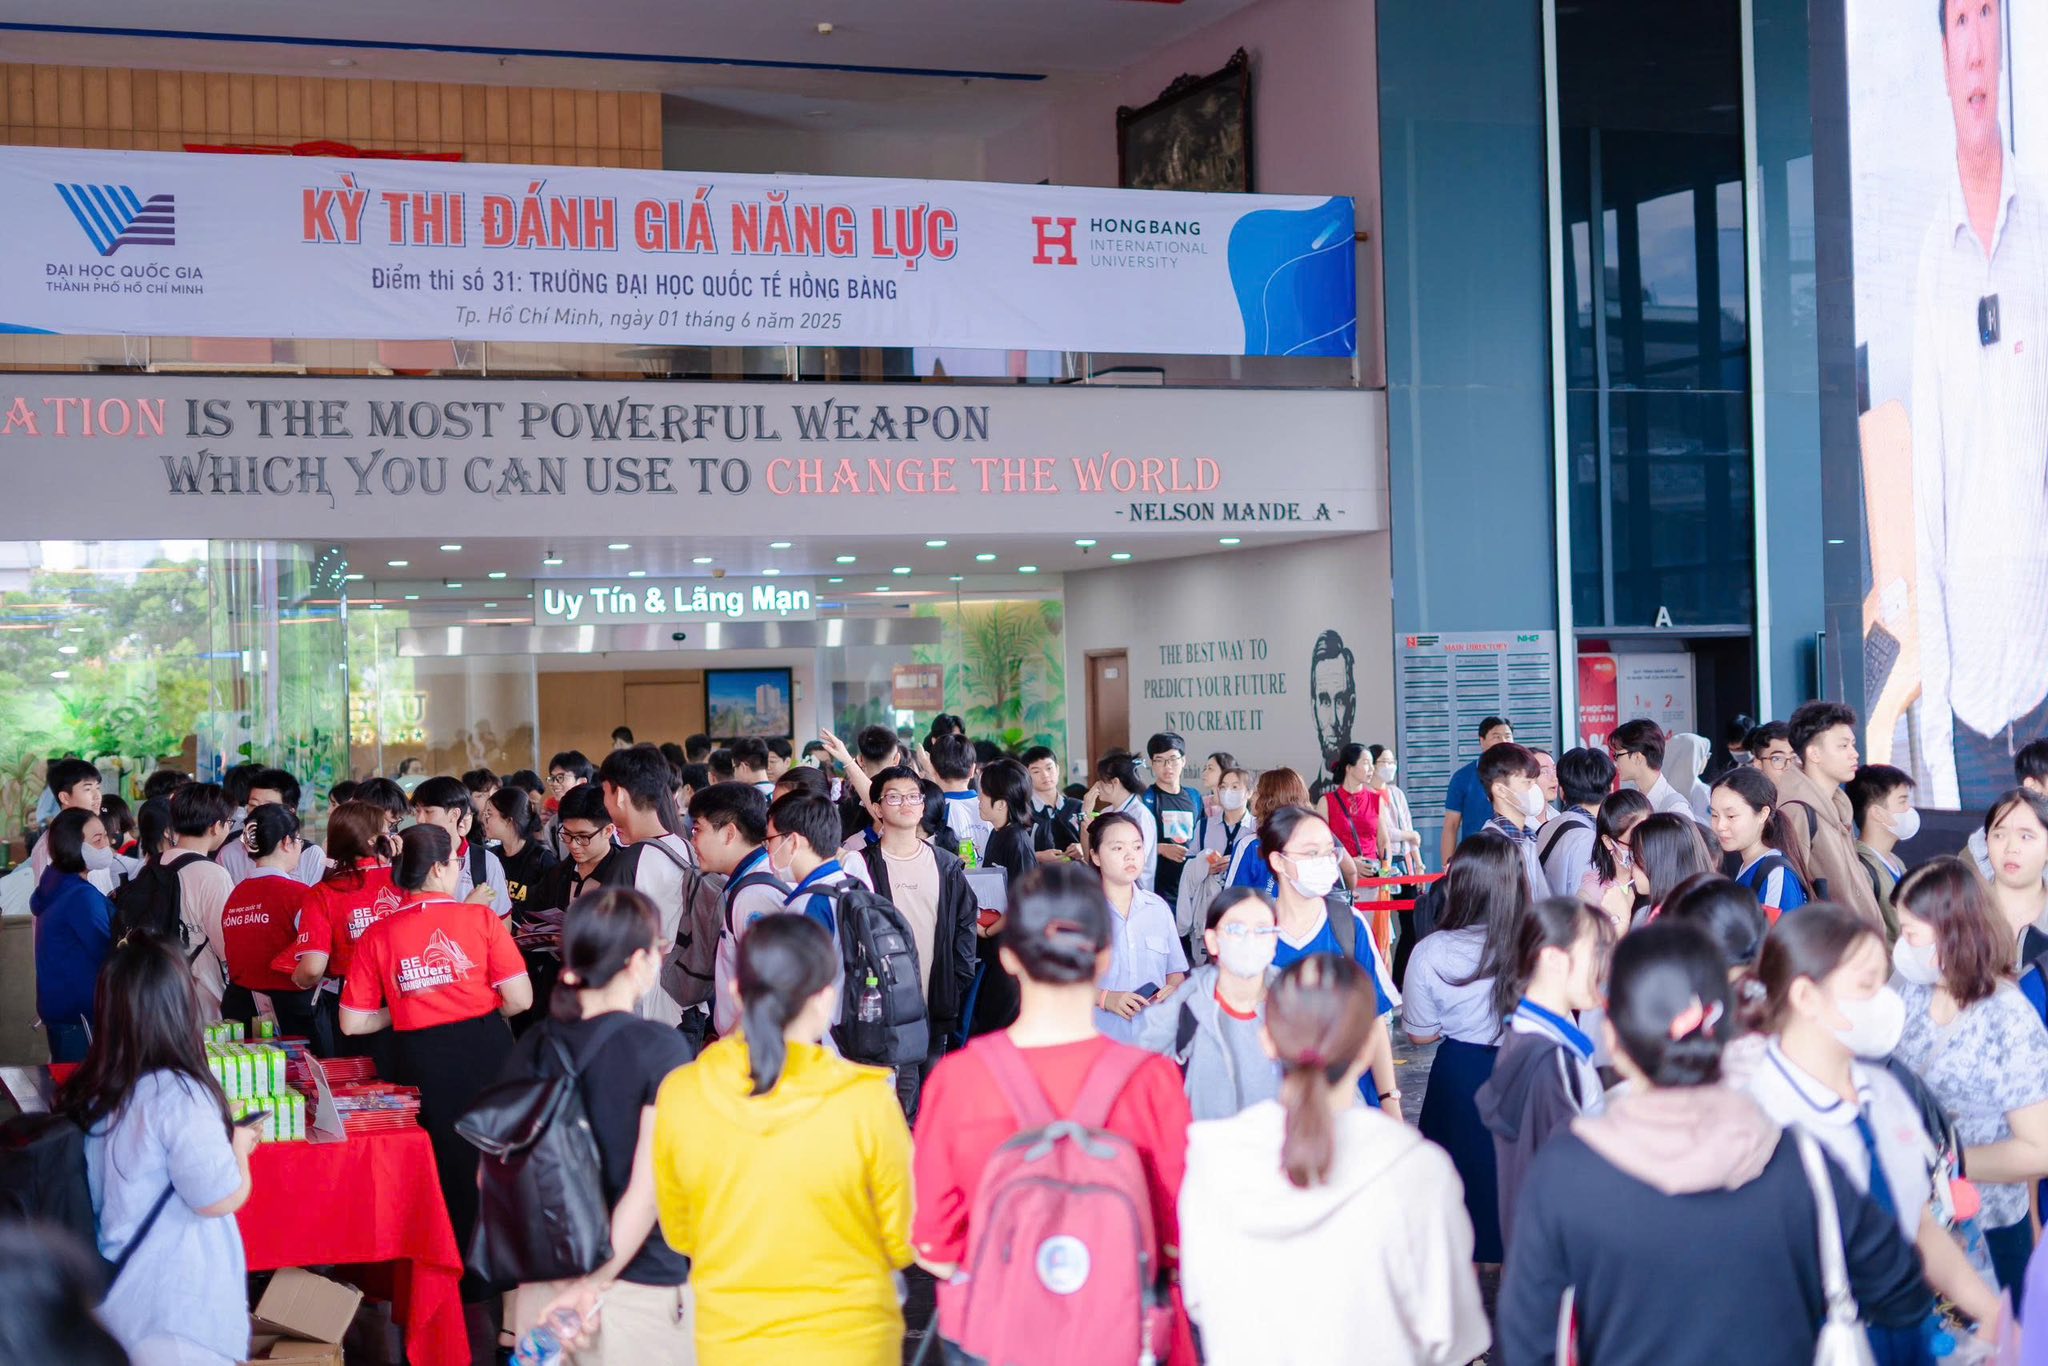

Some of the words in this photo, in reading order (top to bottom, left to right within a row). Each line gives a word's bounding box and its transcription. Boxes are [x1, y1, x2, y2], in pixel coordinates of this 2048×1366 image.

[303, 171, 370, 244] KỲ
[380, 191, 466, 248] THI
[479, 179, 618, 251] ĐÁNH
[635, 185, 718, 254] GIÁ
[732, 188, 857, 258] NĂNG
[872, 202, 958, 271] LỰC
[1031, 215, 1078, 266] H
[1091, 219, 1200, 235] HONGBANG
[1091, 240, 1208, 254] INTERNATIONAL
[46, 264, 72, 279] ĐẠI
[79, 265, 115, 280] HỌC
[121, 263, 170, 278] QUỐC
[176, 267, 202, 279] GIA
[1091, 255, 1177, 268] UNIVERSITY
[46, 280, 89, 291] THÀNH
[94, 281, 120, 292] PHỐ
[146, 282, 168, 293] CHÍ
[172, 285, 203, 294] MINH
[372, 264, 420, 289] Điểm
[429, 269, 453, 290] thi
[463, 267, 483, 291] số
[494, 271, 521, 292] 31:
[530, 269, 607, 293] TRƯỜNG
[617, 274, 647, 298] ĐẠI
[657, 275, 693, 299] HỌC
[703, 269, 752, 297] QUỐC
[760, 270, 781, 297] TẾ
[790, 271, 839, 298] HỒNG
[848, 275, 896, 299] BÀNG
[456, 306, 480, 327] Tp.
[488, 305, 514, 323] Hồ
[519, 307, 550, 324] Chí
[555, 308, 602, 327] Minh,
[611, 309, 653, 330] ngày
[659, 310, 678, 326] 01
[686, 311, 735, 332] tháng
[741, 312, 750, 327] 6
[757, 313, 794, 328] năm
[800, 313, 842, 329] 2025
[1, 397, 166, 437] ATION
[185, 399, 234, 438] IS
[247, 400, 353, 438] THE
[368, 401, 505, 440] MOST
[519, 396, 782, 443] POWERFUL
[792, 397, 989, 441] WEAPON
[160, 448, 334, 509] WHICH
[344, 449, 448, 495] YOU
[464, 457, 567, 495] CAN
[584, 457, 678, 495] USE
[689, 458, 751, 495] TO
[765, 457, 957, 495] CHANGE
[970, 457, 1060, 494] THE
[1071, 450, 1221, 495] WORLD
[1130, 503, 1213, 521] NELSON
[543, 588, 584, 620] Uy
[589, 586, 637, 614] Tín
[644, 586, 667, 613] &
[674, 584, 744, 618] Lãng
[752, 585, 810, 616] Mạn
[1655, 606, 1673, 627] A
[1159, 645, 1182, 665] THE
[1186, 642, 1214, 663] BEST
[1218, 640, 1245, 660] WAY
[1249, 639, 1267, 660] TO
[1144, 678, 1193, 699] PREDICT
[1197, 676, 1232, 697] YOUR
[1235, 673, 1286, 696] FUTURE
[1166, 712, 1175, 731] IS
[1179, 711, 1194, 731] TO
[1198, 710, 1246, 731] CREATE
[1251, 710, 1263, 730] IT
[354, 908, 372, 918] BE
[401, 957, 421, 969] BE
[400, 974, 453, 992] TRANSFORMATIVE
